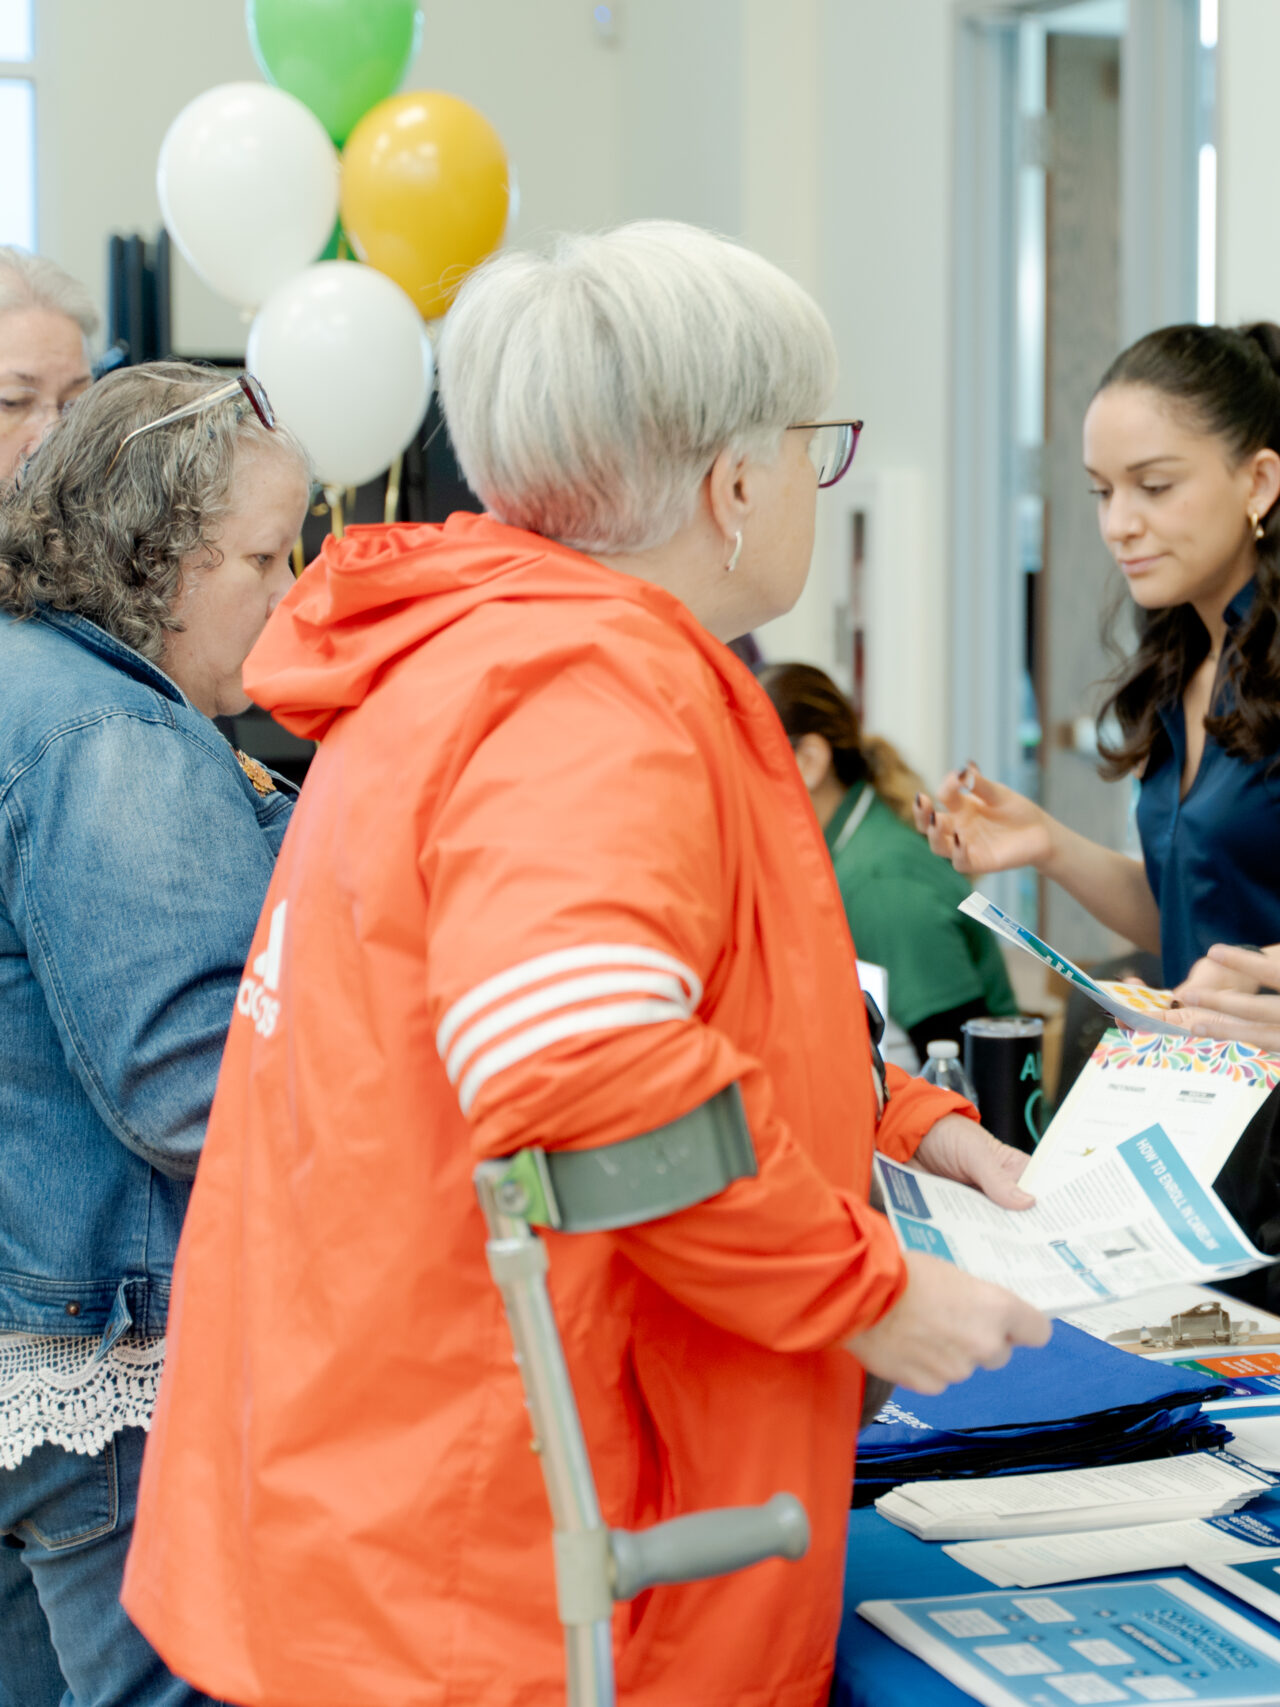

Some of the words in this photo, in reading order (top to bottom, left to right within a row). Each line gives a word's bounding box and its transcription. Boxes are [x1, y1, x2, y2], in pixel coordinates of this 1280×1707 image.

[1136, 1138, 1158, 1162] HOW
[1150, 1158, 1167, 1176] TO
[1158, 1172, 1187, 1209] ENROLL
